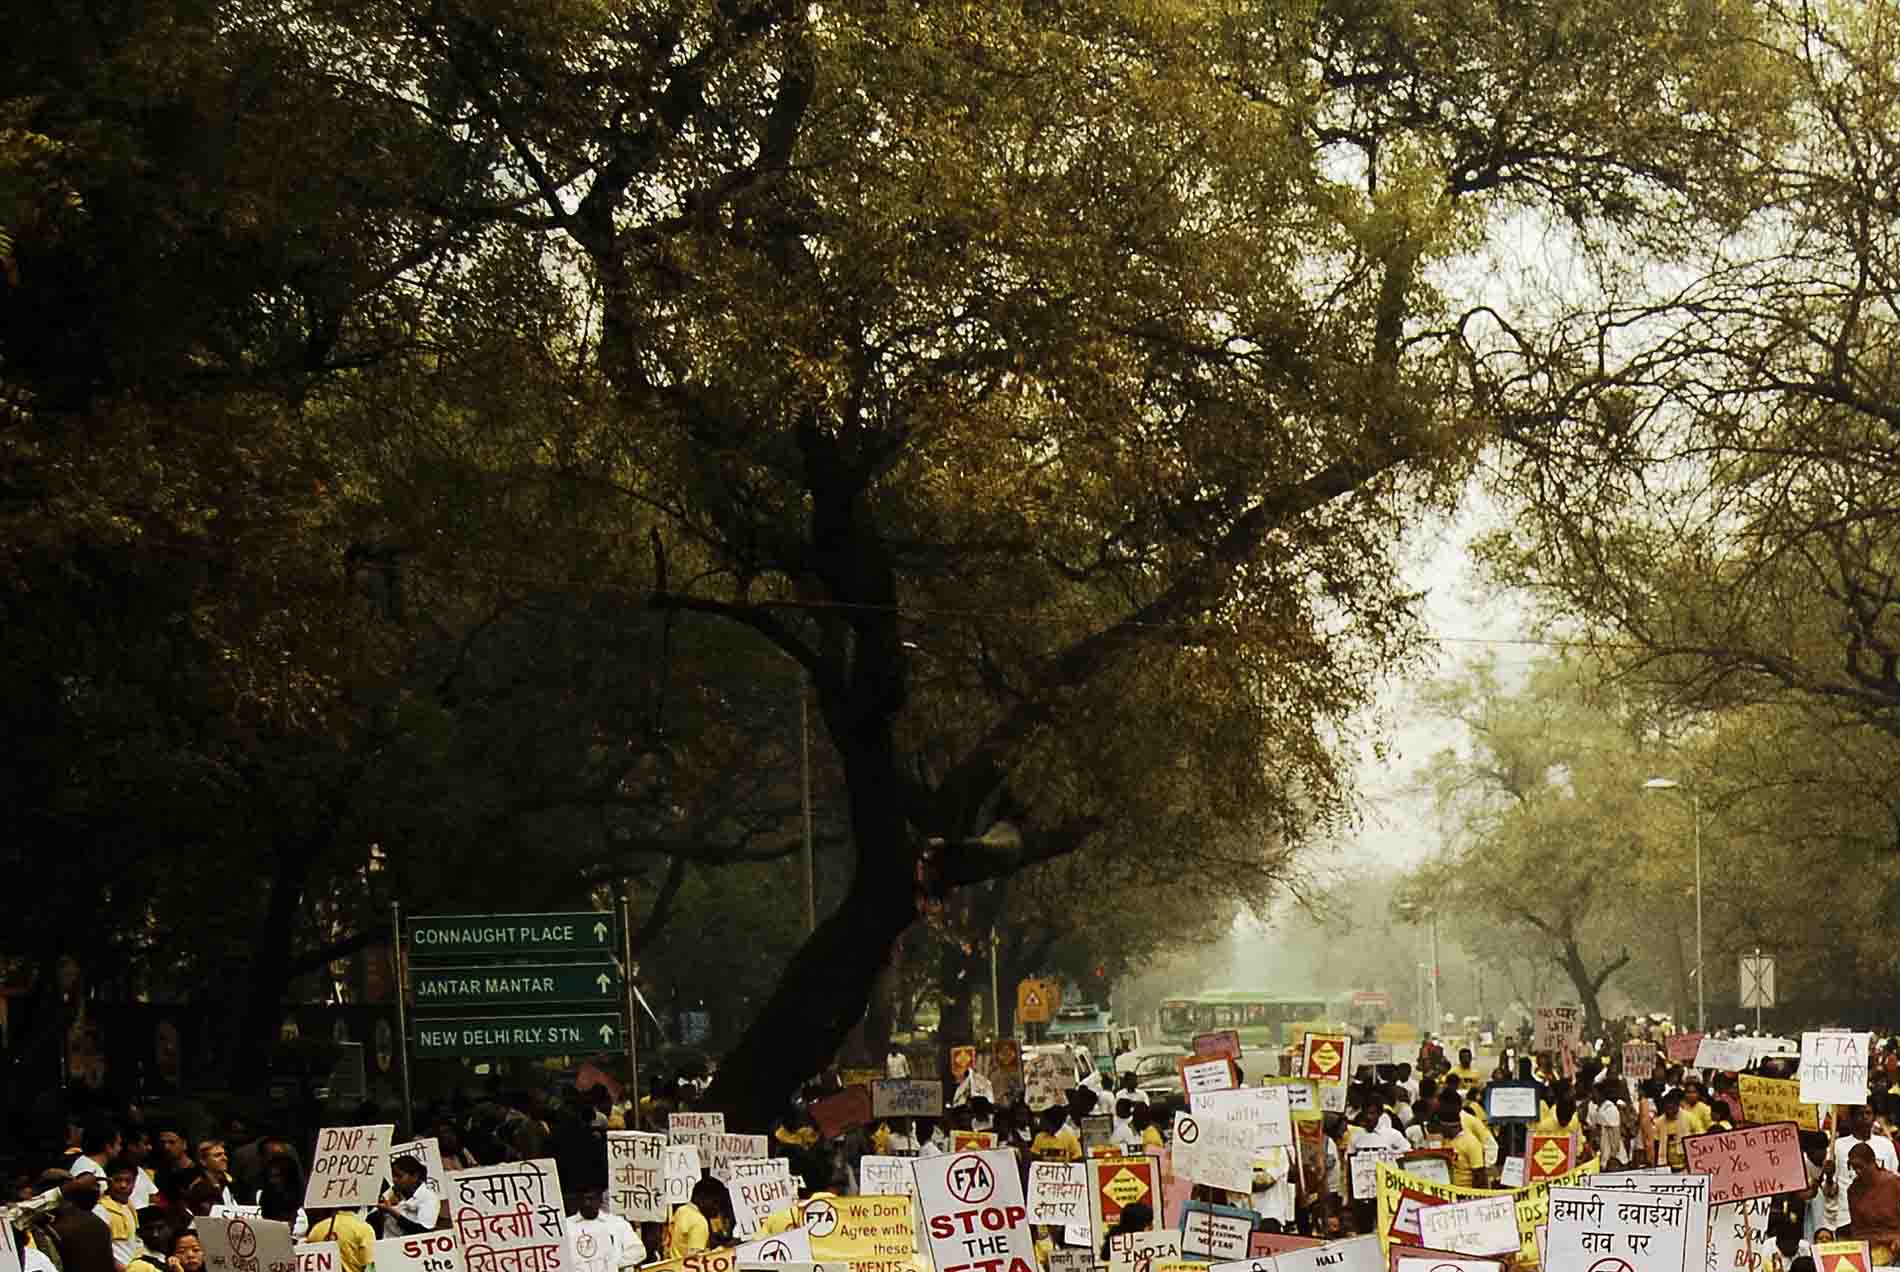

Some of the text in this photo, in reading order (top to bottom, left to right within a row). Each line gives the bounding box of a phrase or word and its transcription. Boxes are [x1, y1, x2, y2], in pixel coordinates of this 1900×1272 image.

[416, 926, 573, 944] CONNAUGHT PLACE
[418, 978, 553, 995] JANTAR MANTAR
[421, 1030, 509, 1046] NEW DELHI
[316, 1156, 378, 1175] OPPOSE
[322, 1179, 359, 1198] FTA
[954, 1168, 990, 1192] FTA
[805, 1210, 835, 1224] FTA
[849, 1206, 869, 1216] We
[930, 1206, 1026, 1240] STOP
[841, 1226, 908, 1238] Agree with
[873, 1243, 908, 1255] these
[962, 1237, 1008, 1258] THE
[1628, 1234, 1651, 1255] पर
[1122, 1247, 1178, 1263] INDIA
[423, 1261, 454, 1272] the
